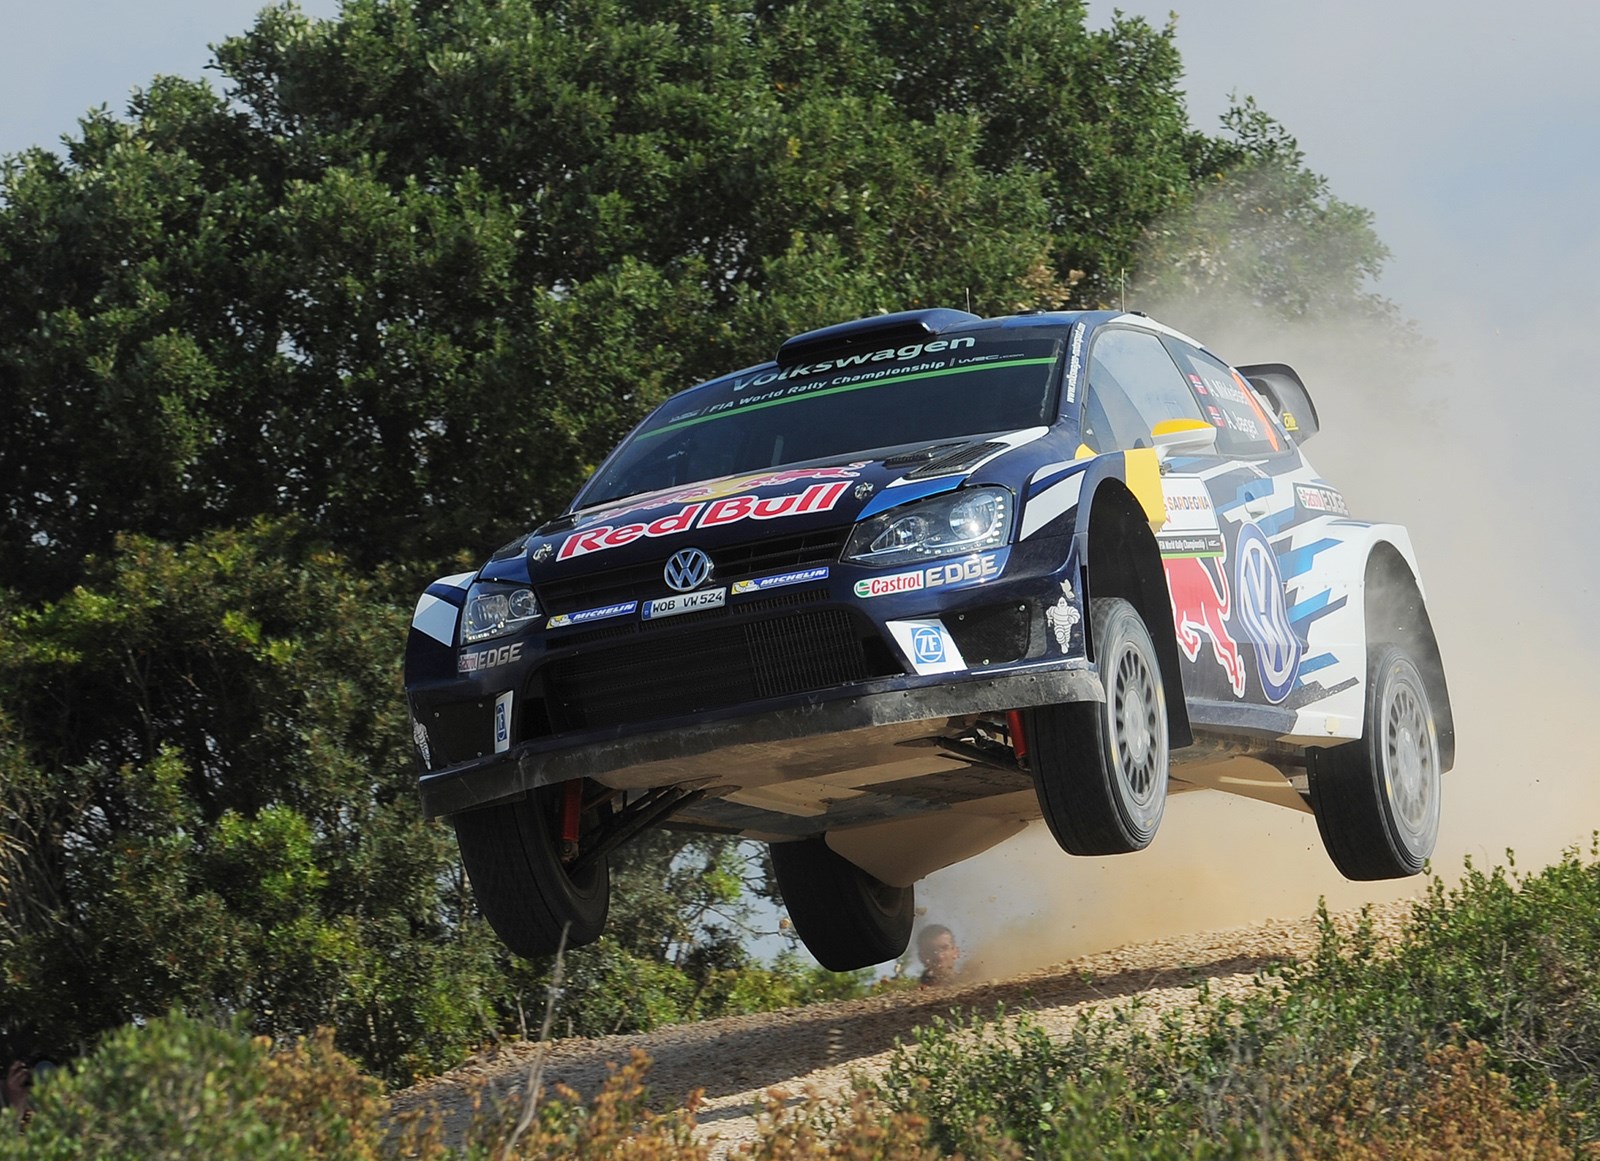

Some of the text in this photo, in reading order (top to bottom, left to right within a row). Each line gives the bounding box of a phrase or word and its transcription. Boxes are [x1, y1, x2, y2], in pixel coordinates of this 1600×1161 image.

[732, 336, 976, 392] Volkswagen
[709, 400, 734, 413] FIA
[739, 391, 782, 406] World
[787, 380, 828, 396] Rally
[831, 361, 945, 386] Championship
[1167, 496, 1210, 511] SARDEGNA
[555, 480, 854, 562] Red Bull
[760, 569, 827, 586] MICHELIN
[871, 554, 999, 594] Castrol EDGE
[573, 603, 635, 621] MICHELIN
[653, 600, 676, 613] WOB
[478, 642, 525, 670] EDGE
